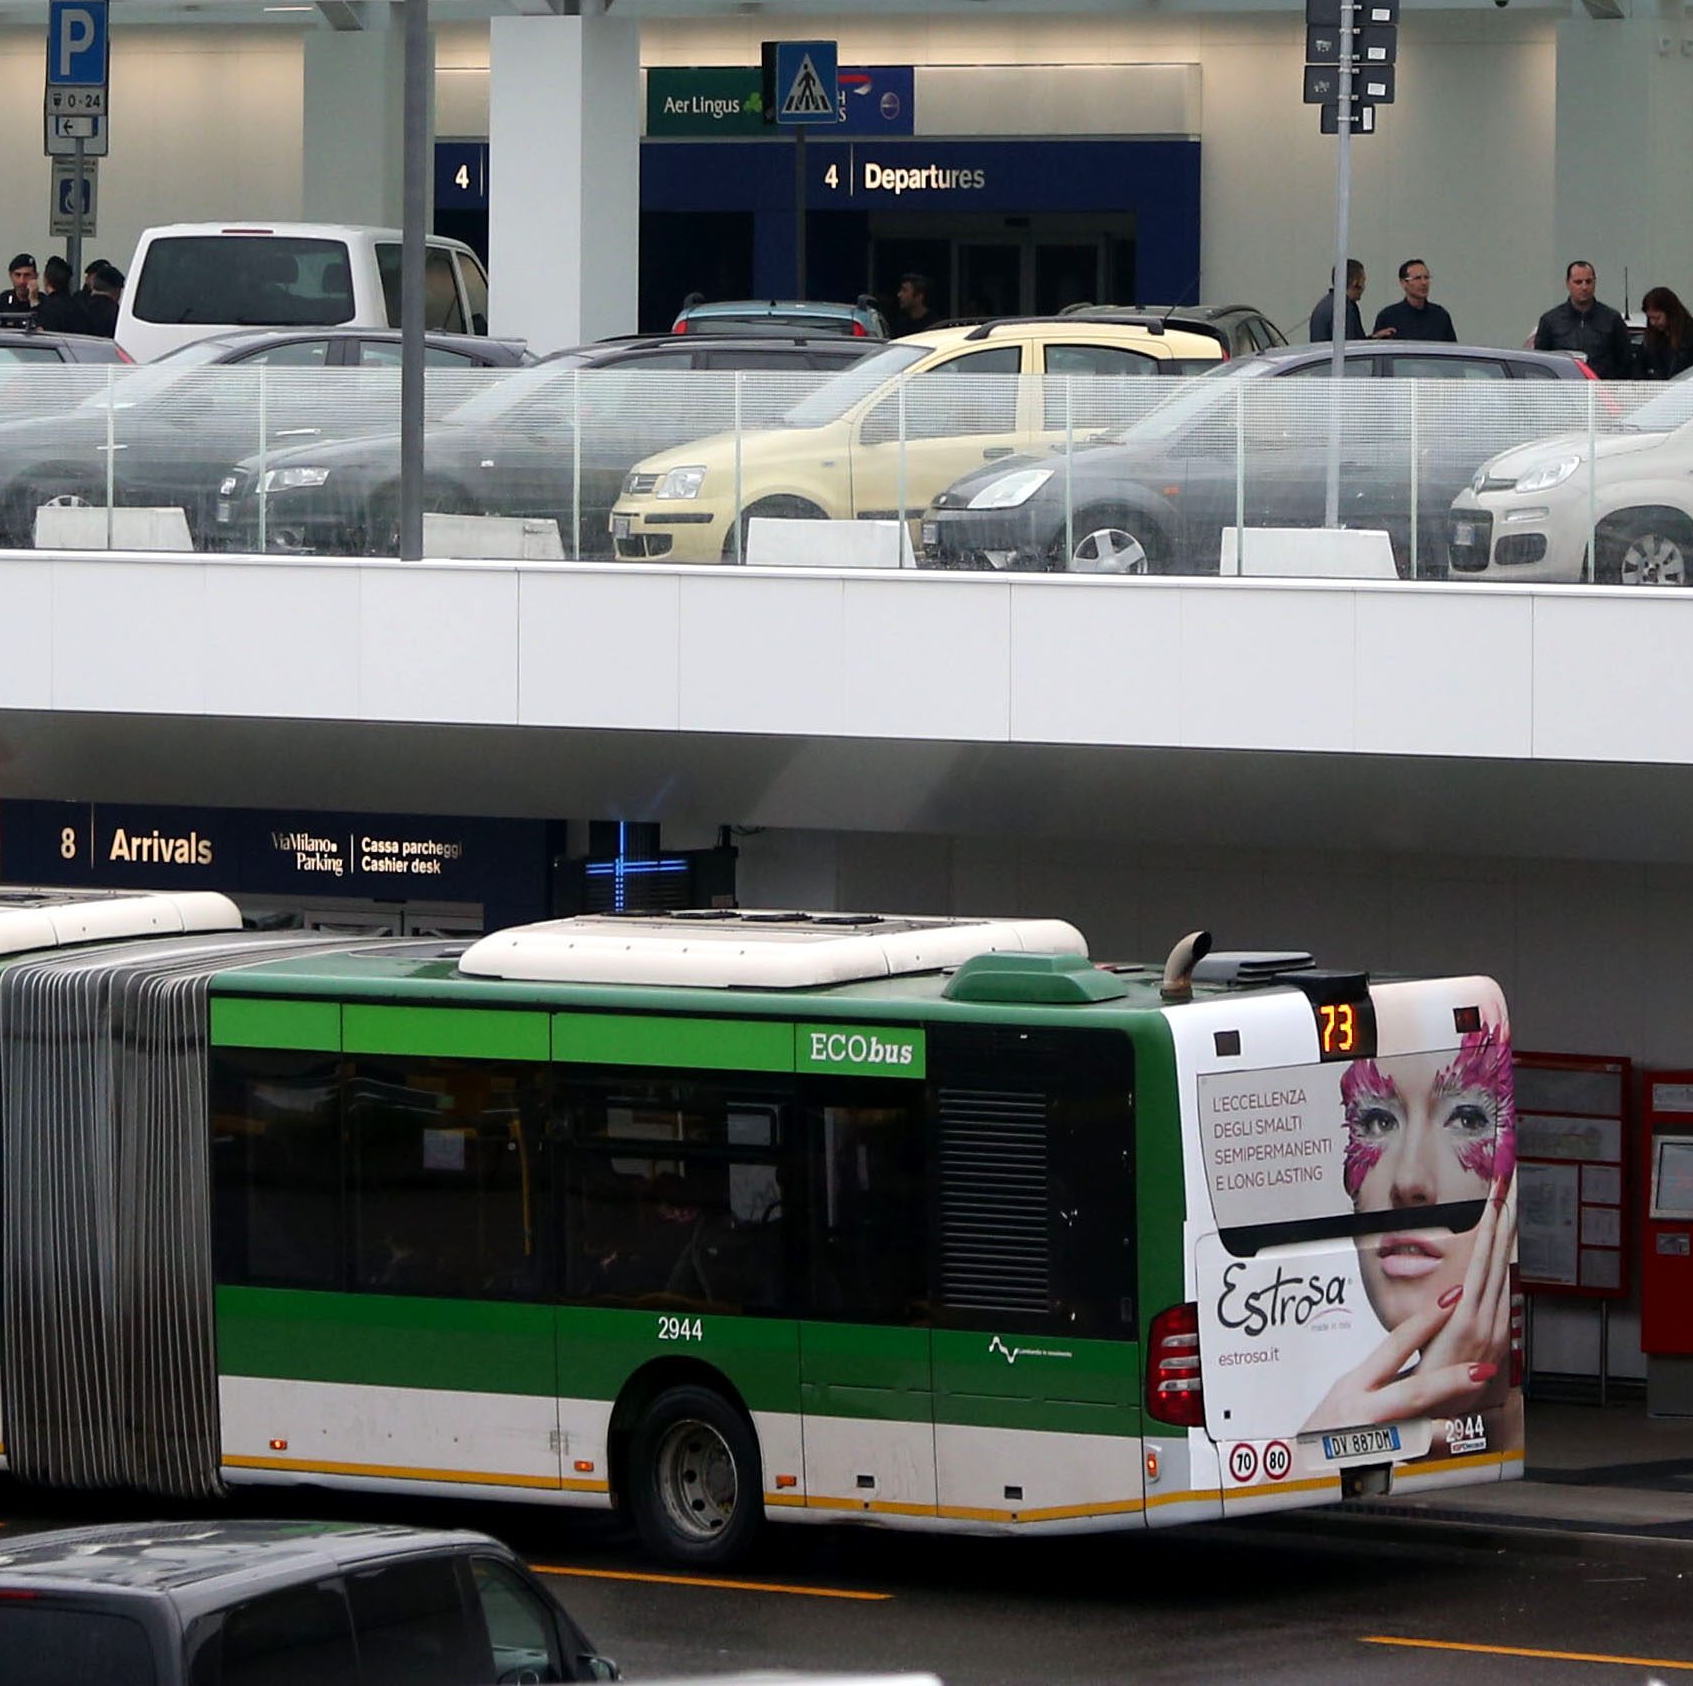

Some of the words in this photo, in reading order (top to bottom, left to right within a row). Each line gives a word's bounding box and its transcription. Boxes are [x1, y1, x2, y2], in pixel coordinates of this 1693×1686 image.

[60, 9, 95, 76] P
[664, 97, 691, 114] Aer
[692, 97, 740, 118] Lingus
[455, 164, 469, 189] 4
[825, 164, 838, 189] 4
[865, 163, 985, 195] Departures
[61, 827, 76, 859] 8
[109, 828, 213, 864] Arrivals
[361, 837, 399, 853] Cassa
[402, 840, 462, 859] parcheggi
[296, 852, 343, 876] Parking
[361, 856, 408, 873] Cashier
[411, 858, 441, 874] desk
[1320, 1004, 1353, 1052] 73
[811, 1033, 913, 1064] ECObus
[1213, 1089, 1307, 1113] L'ECCELLENZA
[1214, 1121, 1252, 1139] DEGLI
[1255, 1115, 1302, 1135] SMALTI
[1215, 1138, 1332, 1165] SEMIPERMANENTI
[1216, 1176, 1224, 1191] E
[1227, 1171, 1265, 1190] LONG
[1268, 1165, 1323, 1186] LASTING
[1217, 1262, 1346, 1337] Estrosa
[658, 1316, 703, 1341] 2944
[1219, 1347, 1280, 1366] estrosa.it
[1445, 1414, 1485, 1442] 2944
[1332, 1436, 1347, 1455] DV
[1352, 1430, 1392, 1452] 887DM
[1237, 1453, 1252, 1472] 70
[1269, 1451, 1286, 1469] 80
